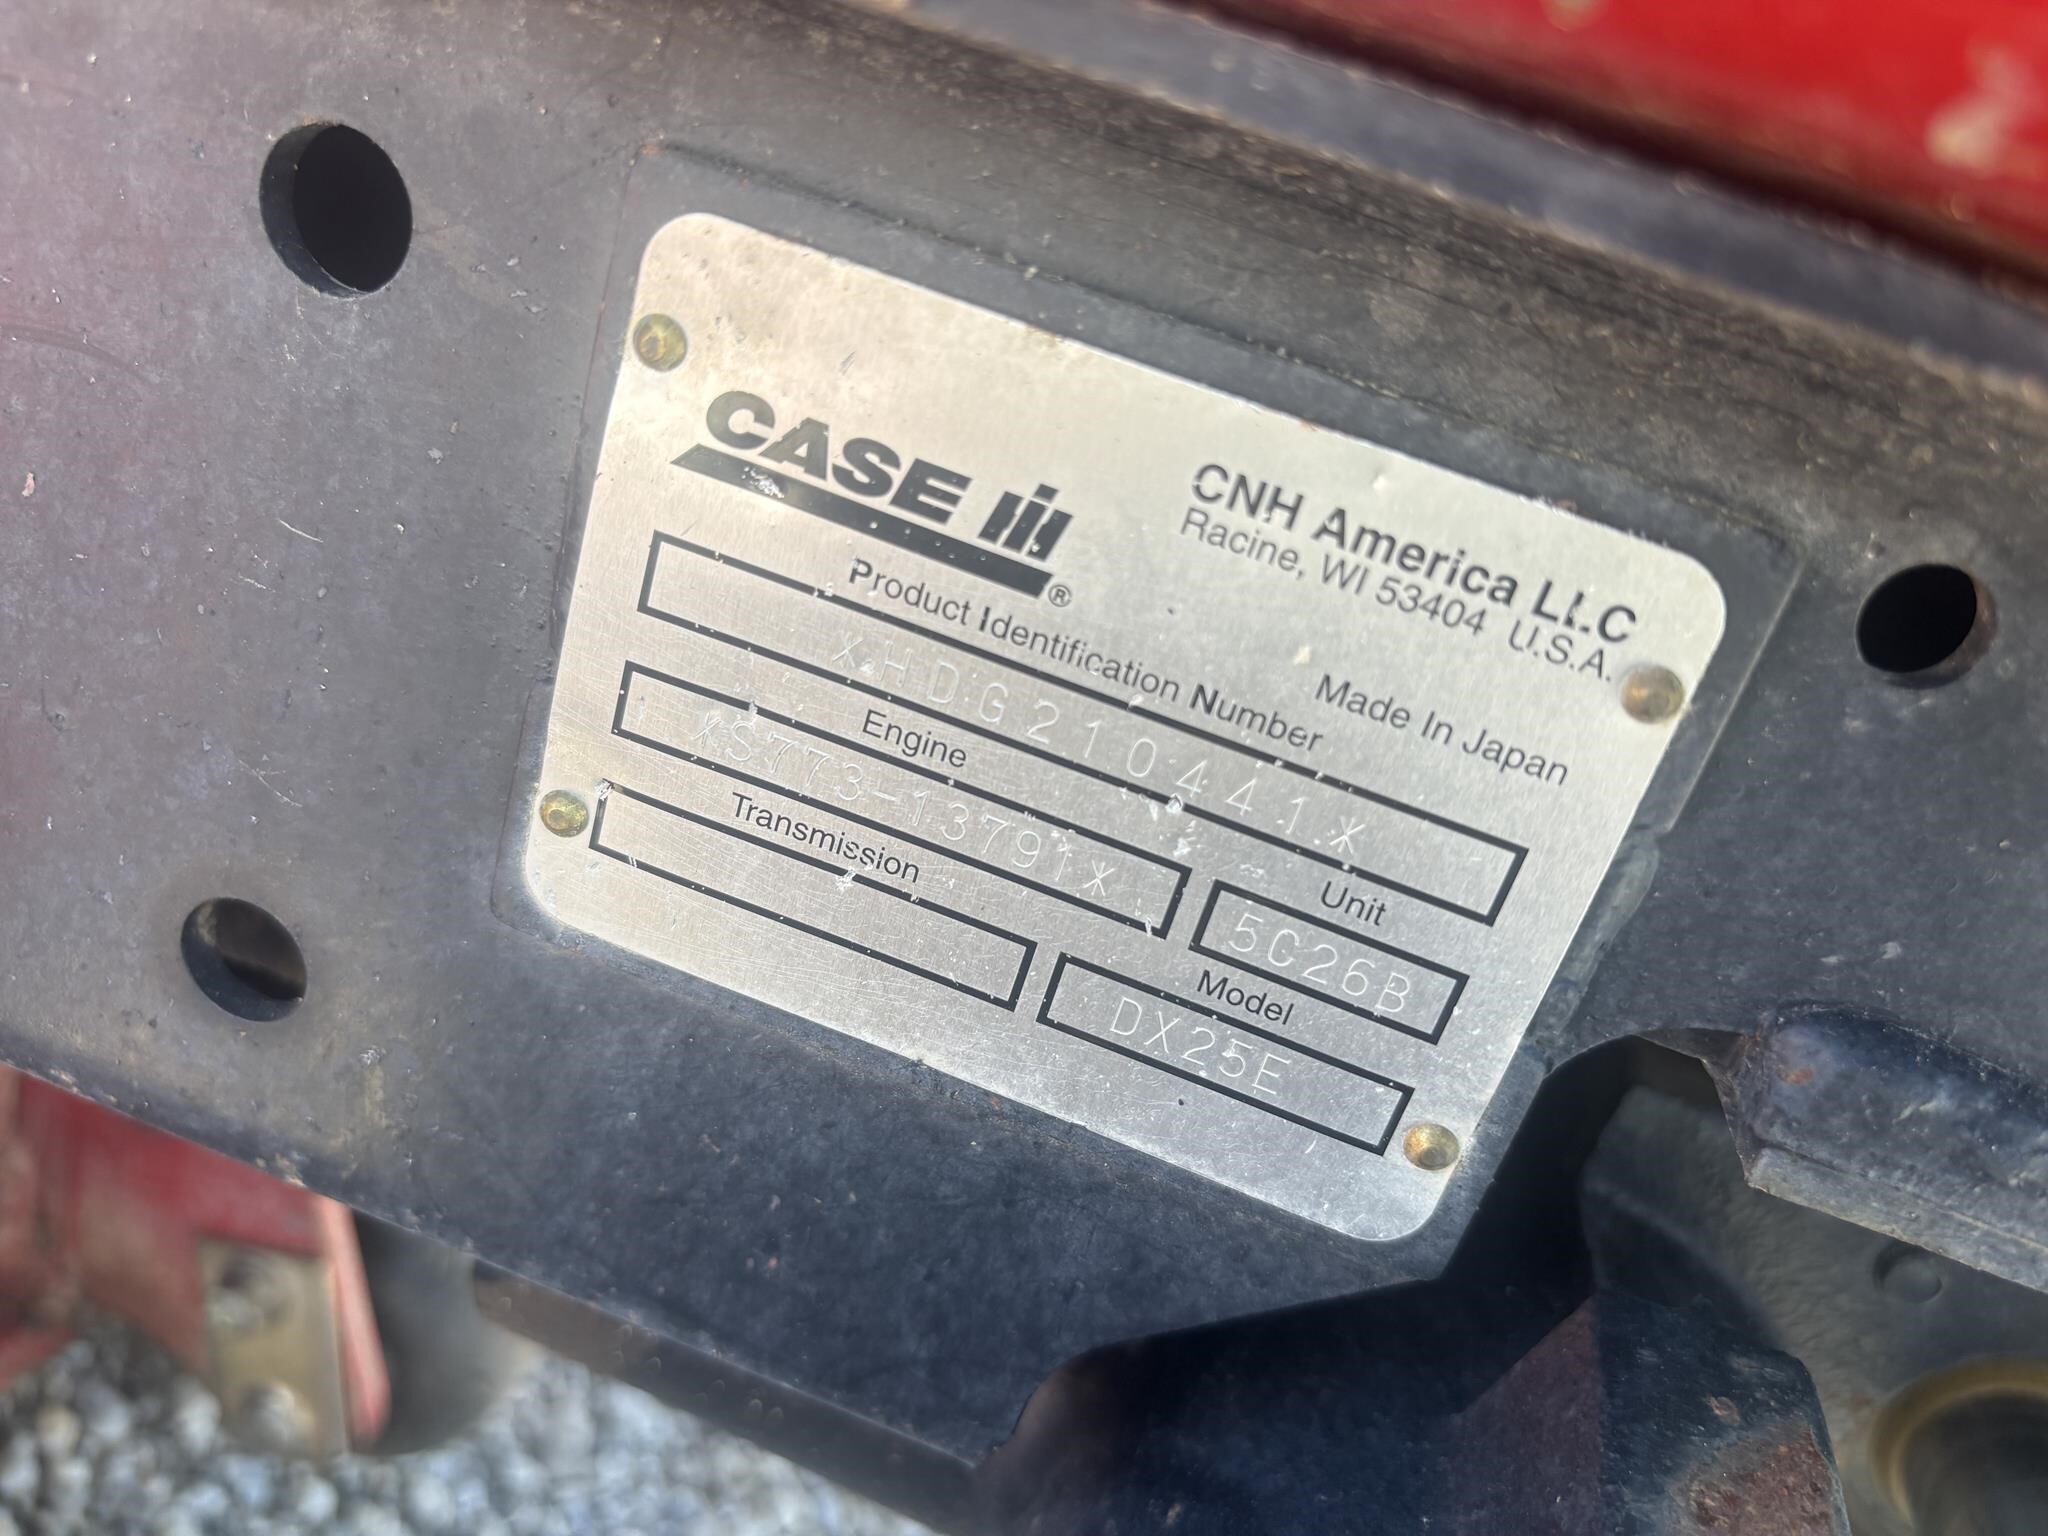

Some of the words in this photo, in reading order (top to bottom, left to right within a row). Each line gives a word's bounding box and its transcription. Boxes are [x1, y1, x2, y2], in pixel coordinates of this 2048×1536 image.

[706, 391, 973, 524] CASE
[1181, 508, 1306, 579] Racine,
[1321, 553, 1371, 597] WI
[1376, 577, 1487, 636] 53404
[1509, 619, 1612, 682] U.S.A.
[1191, 464, 1304, 531] CNH
[1311, 507, 1518, 606] America
[1531, 579, 1637, 643] LLC
[848, 558, 971, 627] Product
[978, 606, 1181, 701] Identification
[1189, 683, 1325, 753] Number
[862, 709, 968, 769] Engine
[1314, 674, 1411, 728] Made
[1421, 711, 1453, 745] In
[1462, 729, 1570, 787] Japan
[731, 792, 921, 884] Transmission
[1320, 880, 1387, 926] Unit
[1196, 969, 1295, 1026] Model
[1227, 912, 1411, 1015] 5C26B
[1109, 996, 1291, 1095] DX25E
